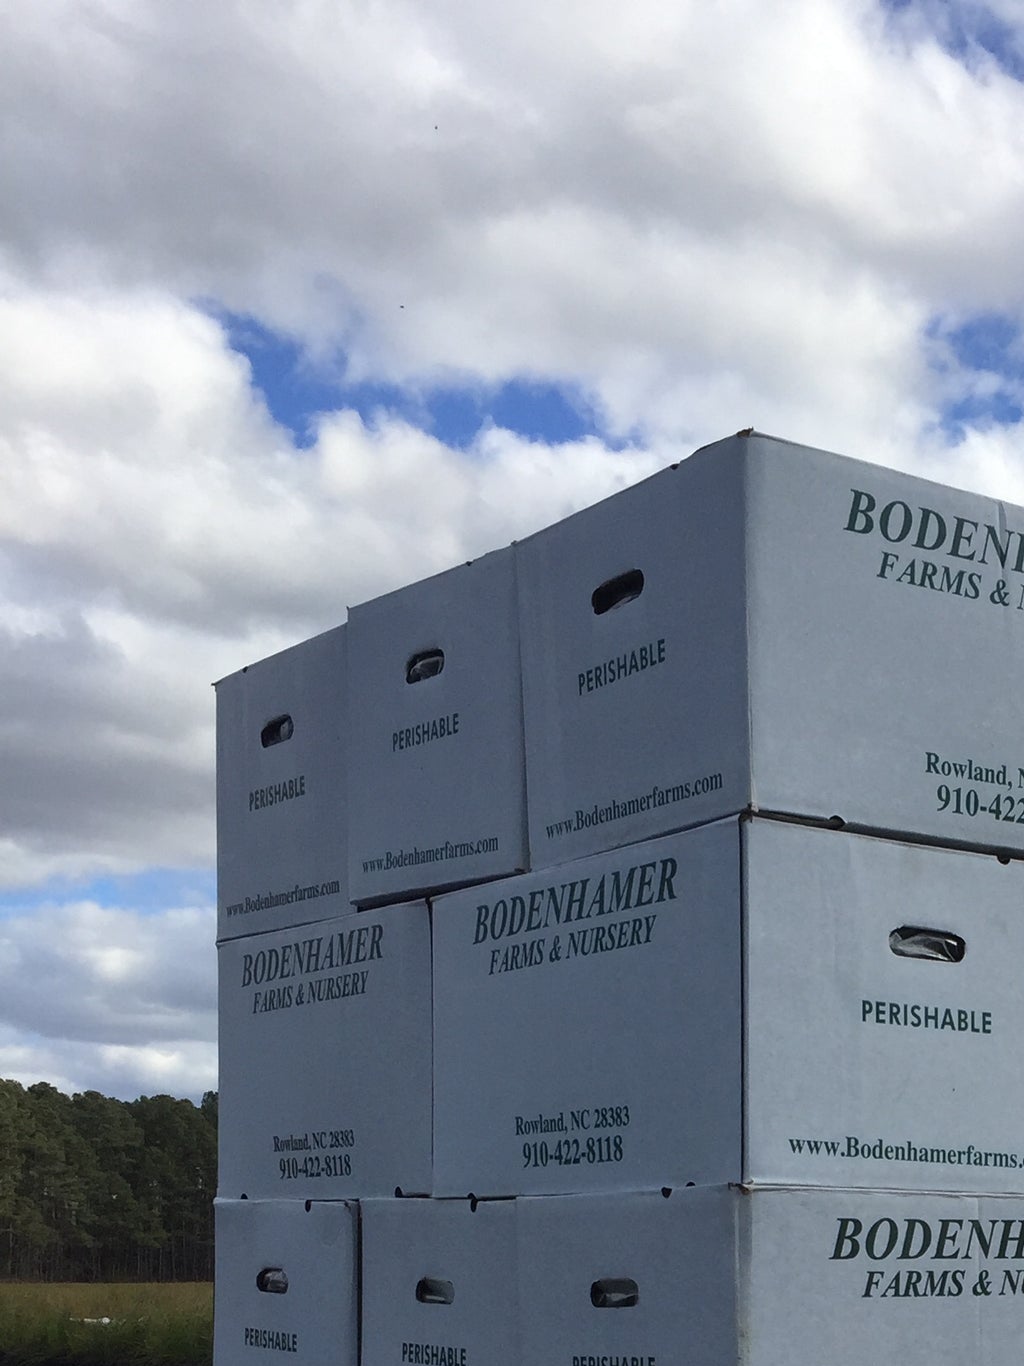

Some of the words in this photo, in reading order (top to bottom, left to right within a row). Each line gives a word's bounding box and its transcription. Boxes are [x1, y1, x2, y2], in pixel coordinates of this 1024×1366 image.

[877, 552, 982, 599] FARMS
[990, 579, 1009, 606] &
[578, 639, 665, 696] PERISHABLE
[393, 713, 459, 752] PERISHABLE
[925, 752, 1012, 791] Rowland,
[249, 776, 305, 812] PERISHABLE
[546, 773, 723, 839] www.Bodenhamerfarms.com
[363, 837, 498, 872] www.Bodenhamerfarms.com
[227, 880, 340, 917] www.Bodenhamerfarms.com
[473, 858, 677, 945] BODENHAMER
[242, 924, 383, 987] BODENHAMER
[488, 938, 545, 975] FARMS
[549, 935, 561, 963] &
[566, 915, 657, 959] NURSERY
[253, 985, 293, 1014] FARMS
[295, 983, 304, 1006] &
[307, 970, 369, 1004] NURSERY
[862, 1000, 991, 1034] PERISHABLE
[312, 1132, 327, 1150] NC
[329, 1129, 354, 1148] 28383
[515, 1112, 568, 1136] Rowland,
[570, 1109, 590, 1131] NC
[593, 1106, 630, 1128] 28383
[280, 1154, 351, 1180] 910-422-8118
[523, 1135, 623, 1168] 910-422-8118
[861, 1270, 966, 1298] FARMS
[972, 1270, 992, 1296] &
[245, 1328, 297, 1352] PERISHABLE
